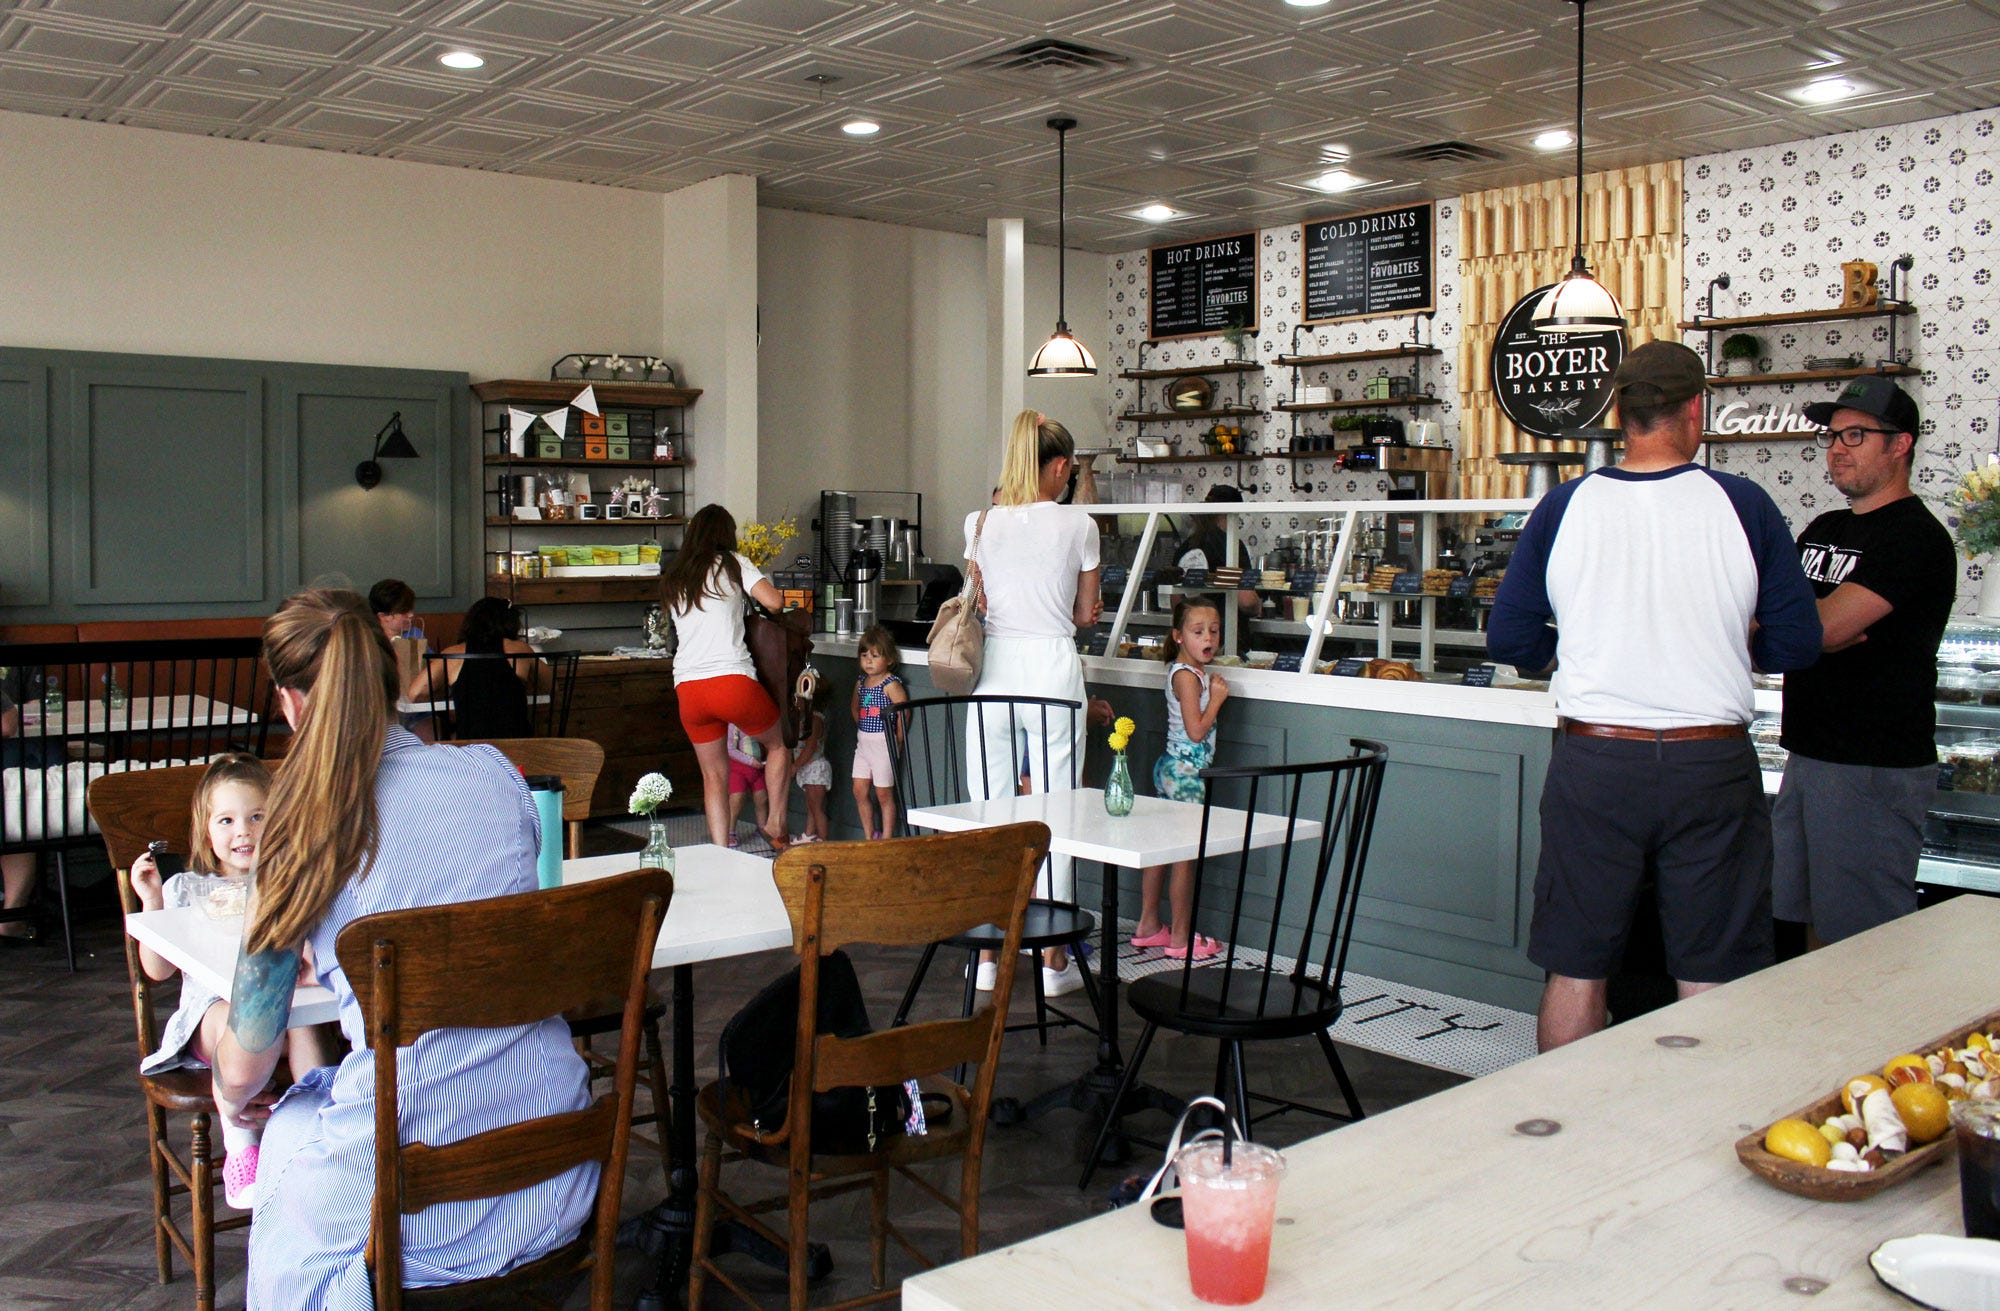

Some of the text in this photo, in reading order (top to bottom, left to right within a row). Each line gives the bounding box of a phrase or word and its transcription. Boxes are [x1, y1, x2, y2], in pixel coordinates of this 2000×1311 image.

[1320, 212, 1416, 241] COLD DRINKS
[1167, 241, 1240, 264] HOT DRINKS
[1370, 261, 1420, 278] FAVORITES
[1206, 291, 1248, 305] FAVORITES
[1539, 333, 1568, 345] THE
[1506, 347, 1609, 379] BOYER
[1513, 379, 1601, 394] BAKERY
